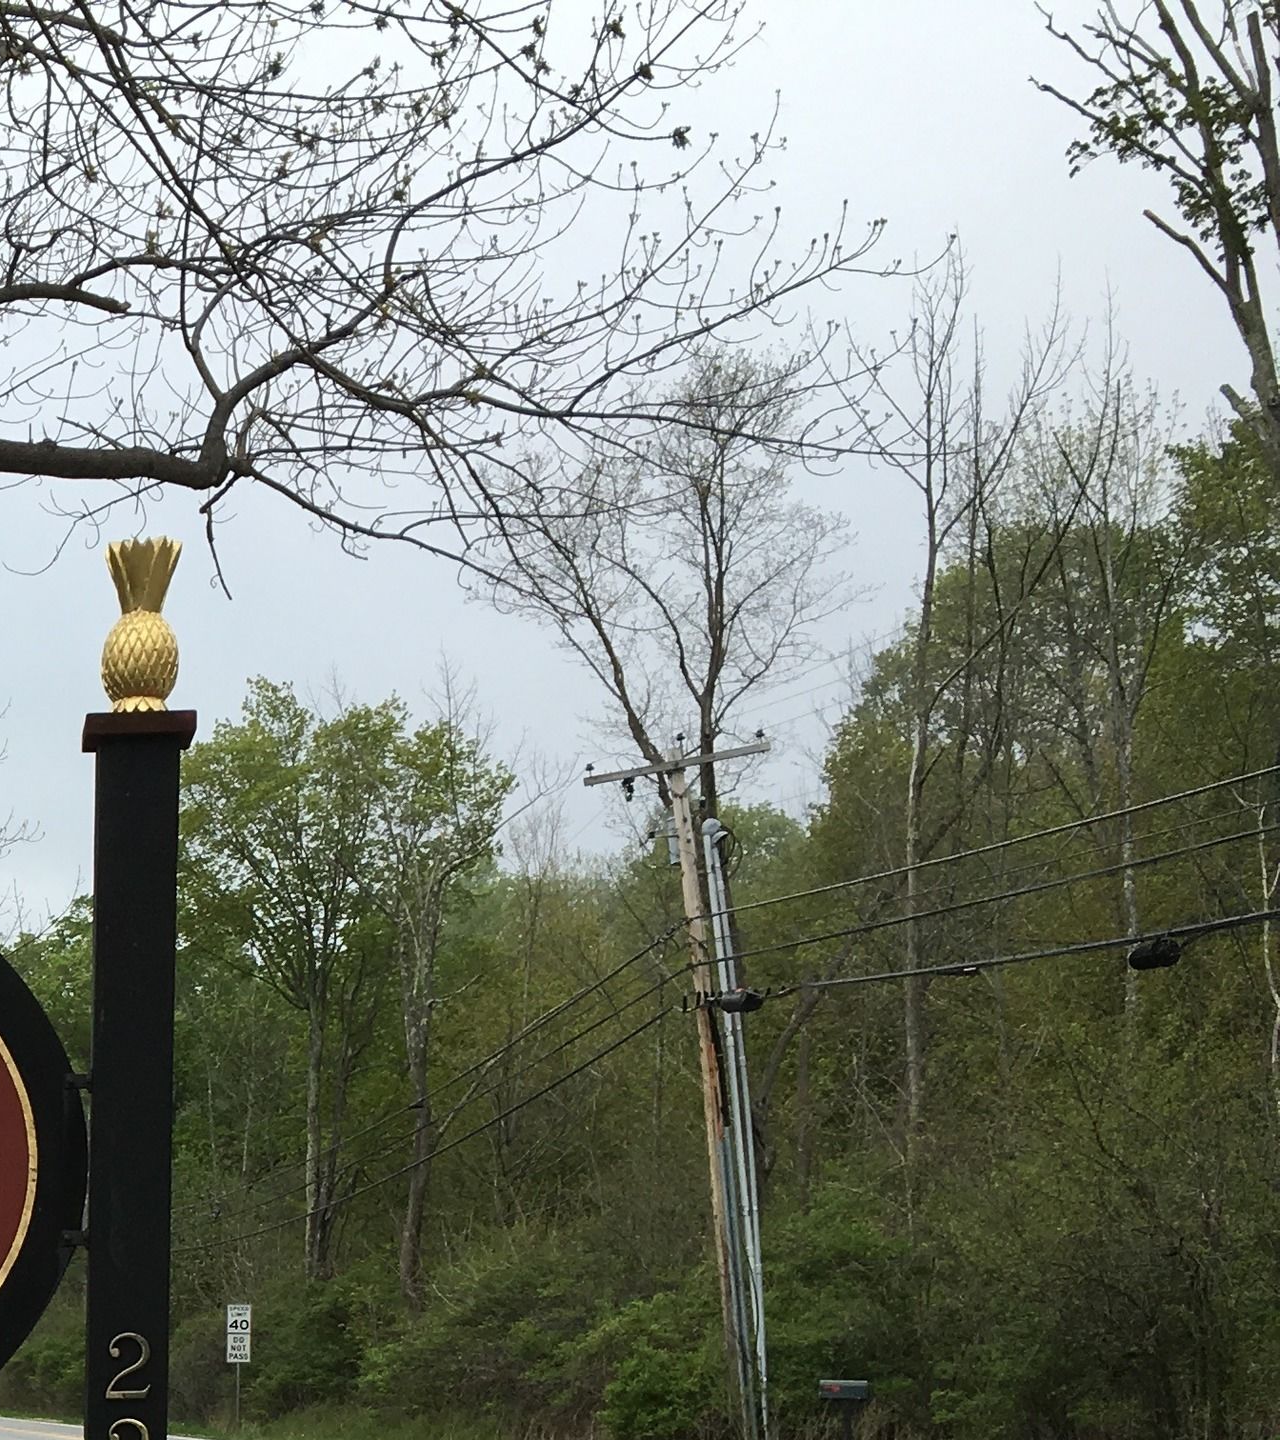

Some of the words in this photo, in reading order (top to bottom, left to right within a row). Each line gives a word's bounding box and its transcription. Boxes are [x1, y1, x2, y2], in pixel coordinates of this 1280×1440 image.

[229, 1319, 249, 1330] 40
[232, 1336, 245, 1344] DO
[230, 1344, 246, 1352] NOT
